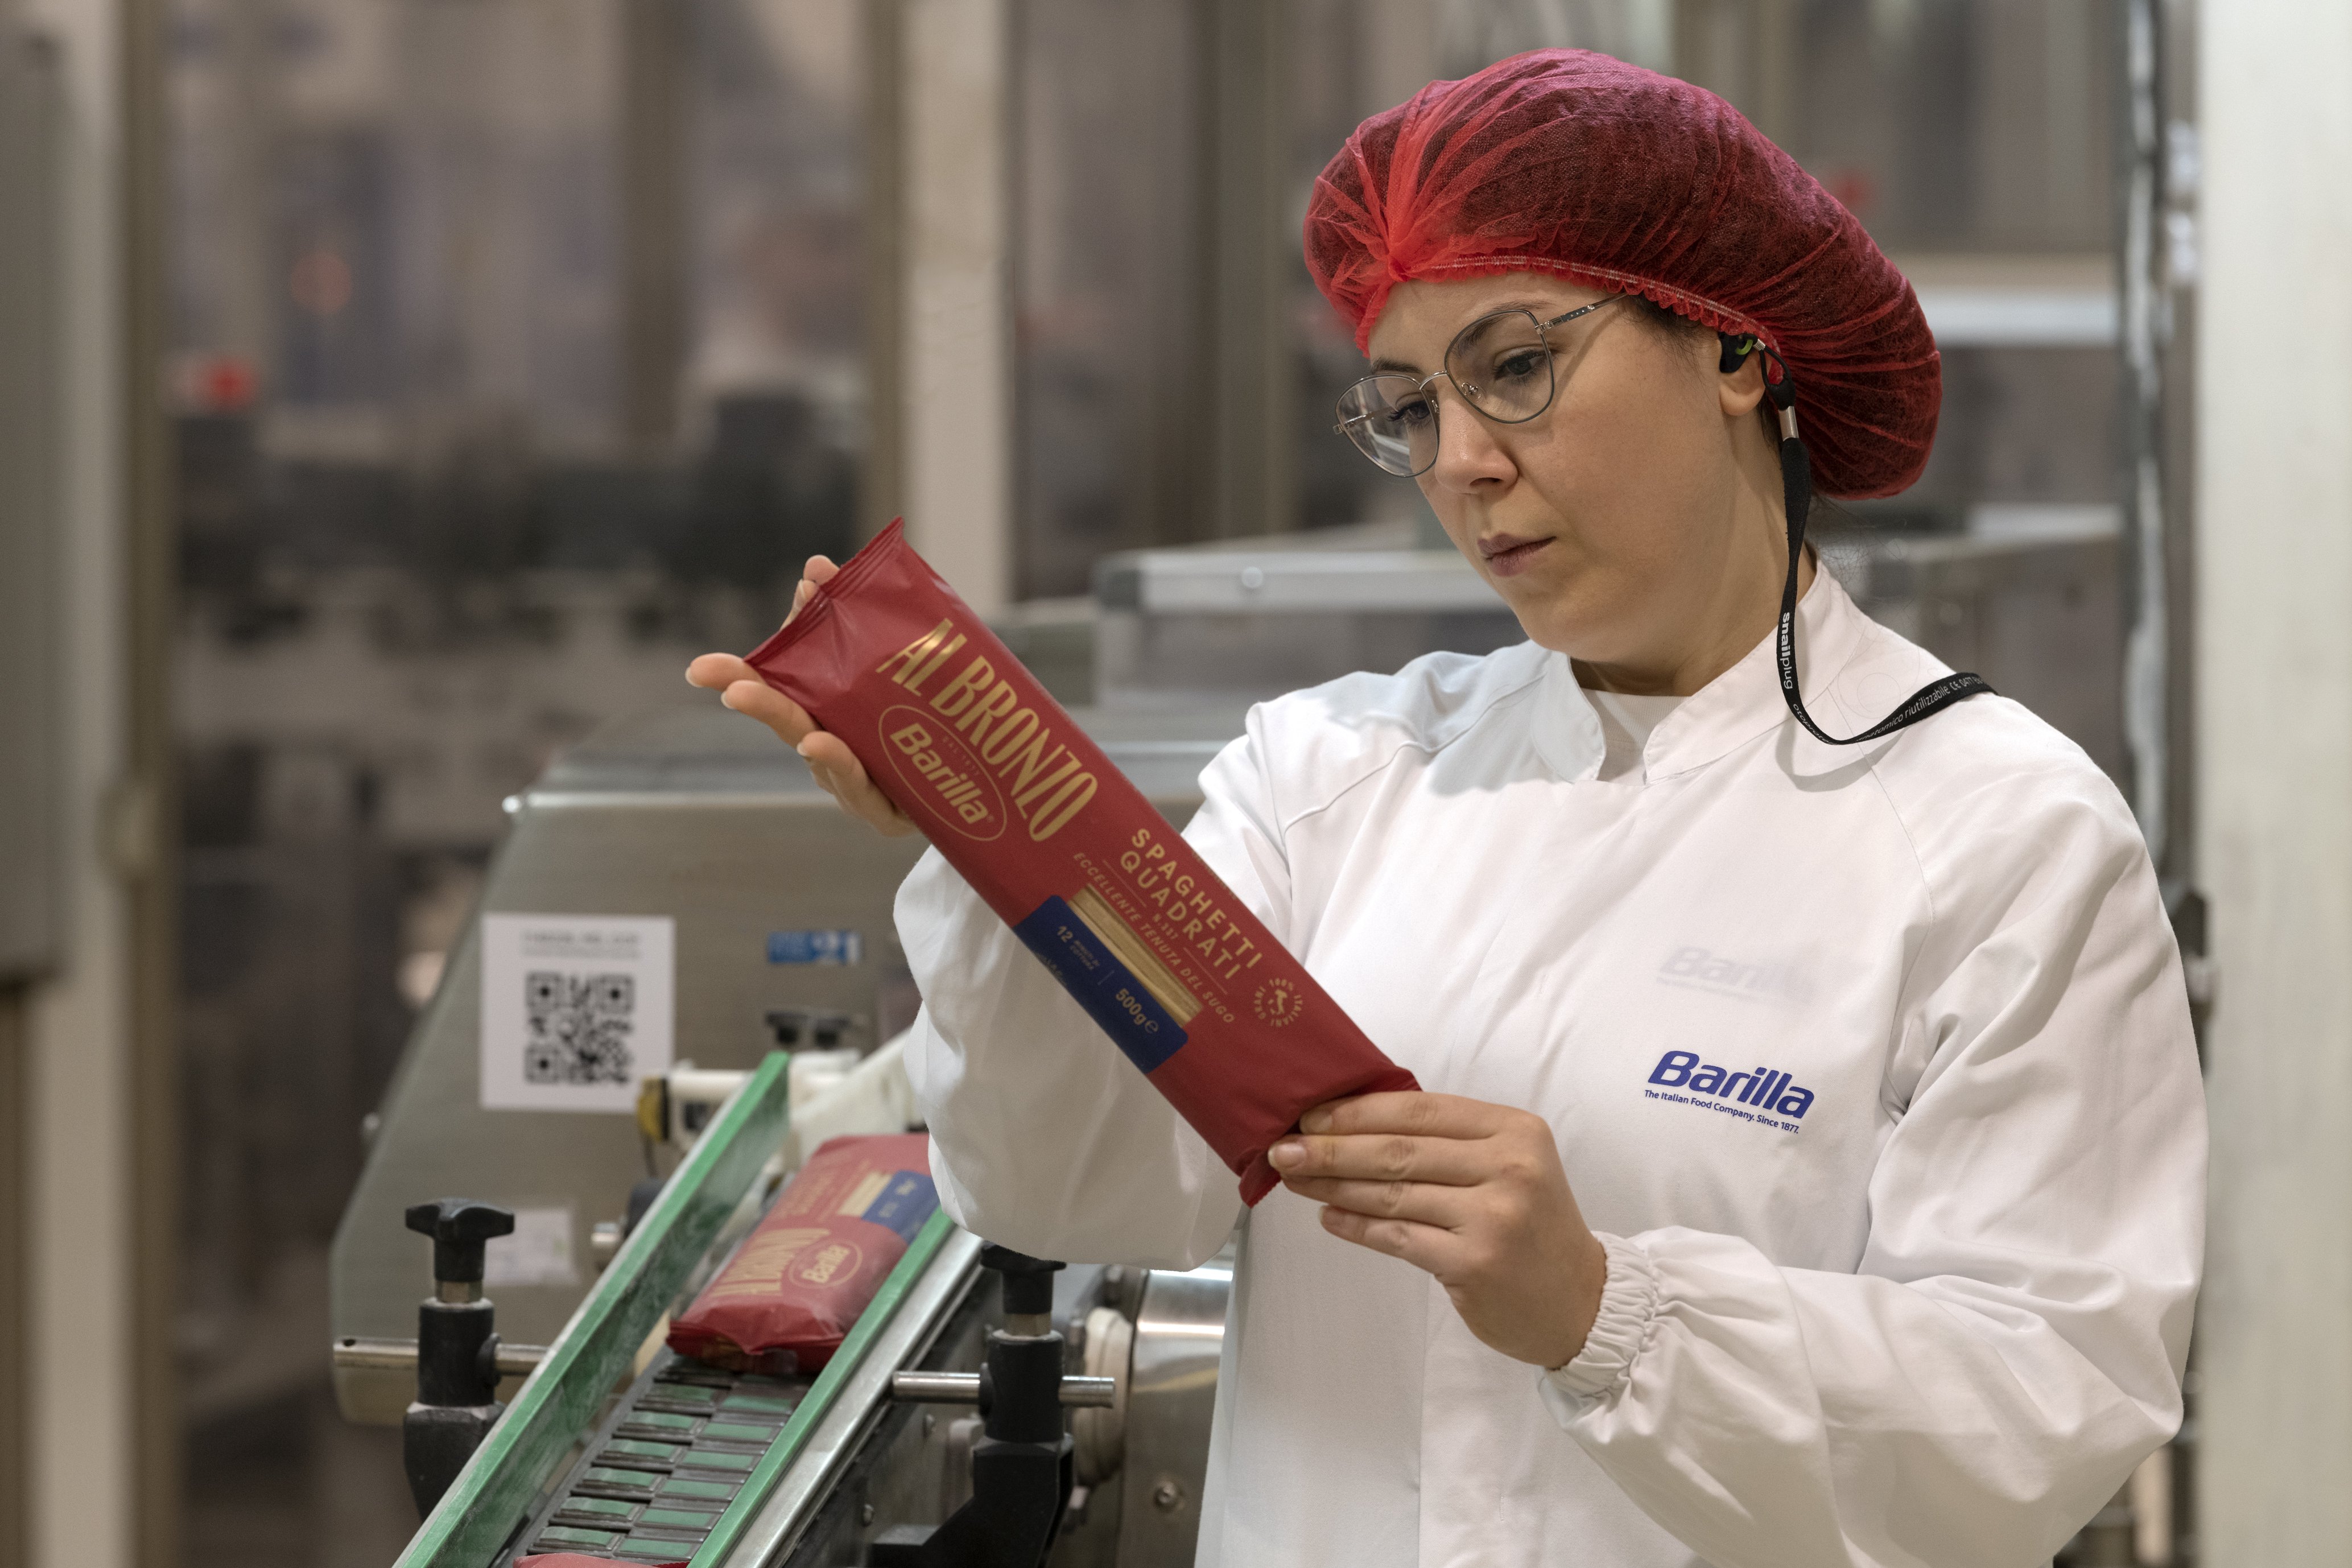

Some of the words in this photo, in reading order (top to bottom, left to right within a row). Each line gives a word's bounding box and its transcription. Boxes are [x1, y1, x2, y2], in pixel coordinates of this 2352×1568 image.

[1780, 612, 1793, 690] snailplug
[876, 617, 967, 697] AL
[929, 655, 1098, 842] BRONZO
[1905, 684, 1951, 719] riutilizzabile
[889, 723, 989, 824] Barilla
[1057, 925, 1074, 943] 12
[1074, 853, 1142, 922] ECCELLENTE
[1140, 923, 1182, 966] TENUTA
[1179, 967, 1203, 990] DEL
[1202, 992, 1235, 1023] SUGO
[1120, 850, 1241, 980] QUADRATI
[1132, 828, 1263, 968] SPAGHETTI
[1645, 1090, 1659, 1099] The
[1661, 1092, 1689, 1104] Italian
[1690, 1097, 1713, 1109] Food
[1714, 1103, 1755, 1121] Company.
[1756, 1114, 1779, 1128] Since
[1781, 1121, 1800, 1134] 1877.
[1648, 1050, 1814, 1119] Barilla
